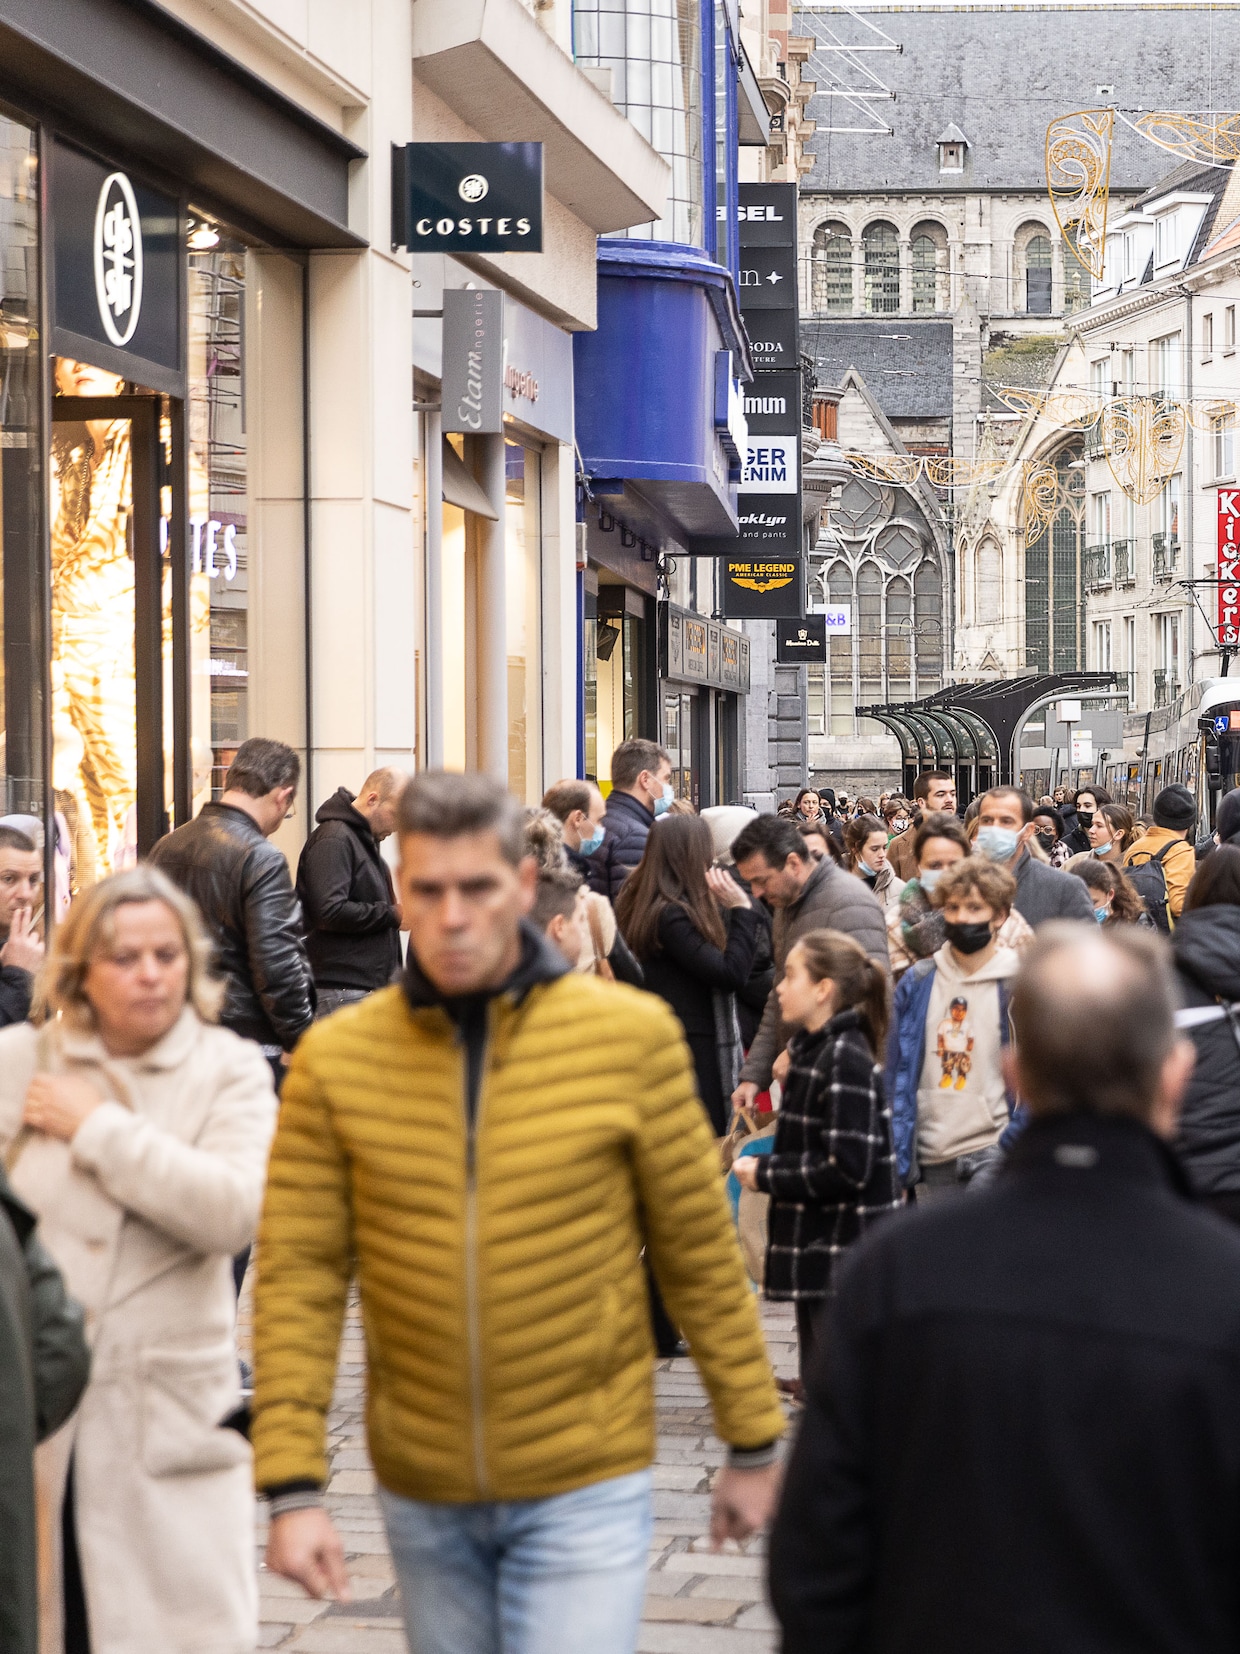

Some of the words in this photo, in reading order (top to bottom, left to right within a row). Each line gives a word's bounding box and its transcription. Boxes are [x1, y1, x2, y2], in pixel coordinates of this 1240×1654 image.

[416, 218, 531, 236] COSTES
[458, 351, 482, 429] Etam
[762, 531, 787, 539] pants
[728, 563, 752, 573] PME
[753, 563, 796, 573] LEGEND
